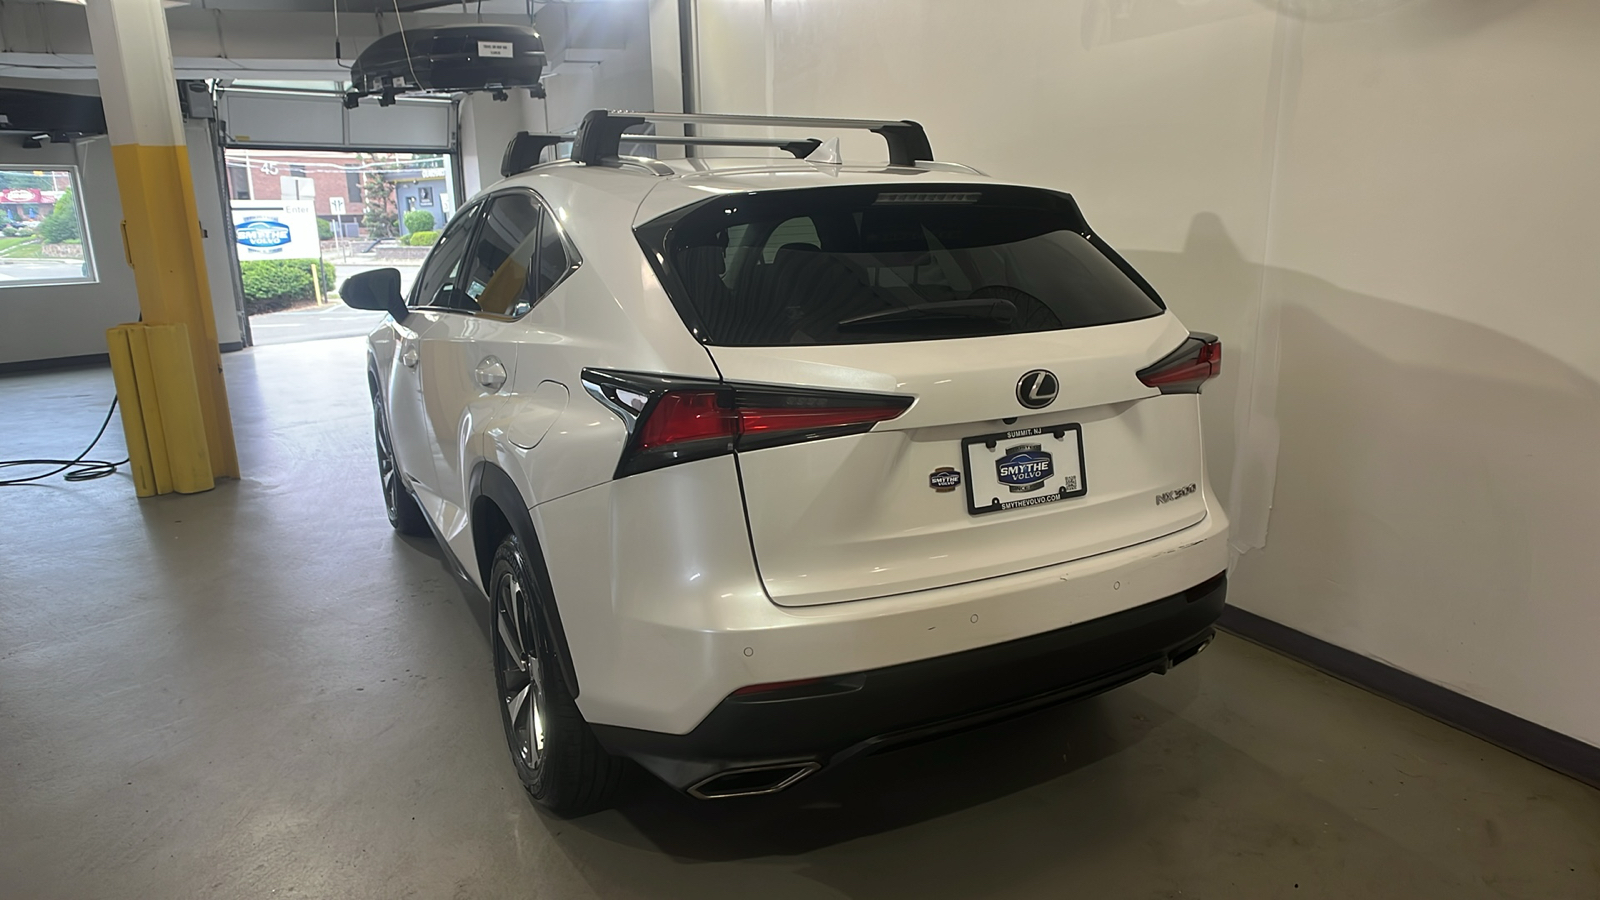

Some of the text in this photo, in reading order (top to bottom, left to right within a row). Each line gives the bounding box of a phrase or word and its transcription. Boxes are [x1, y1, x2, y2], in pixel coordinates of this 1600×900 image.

[260, 162, 279, 176] 45
[285, 206, 309, 214] Enter
[237, 230, 289, 240] SMYTHE
[1033, 427, 1042, 435] NJ
[1000, 461, 1049, 477] SMYTHE
[931, 476, 959, 484] SMYTHE
[1012, 470, 1042, 481] VOLVO
[1155, 483, 1197, 506] NX300
[1001, 493, 1061, 511] SMYTHEVOLVO.COM
